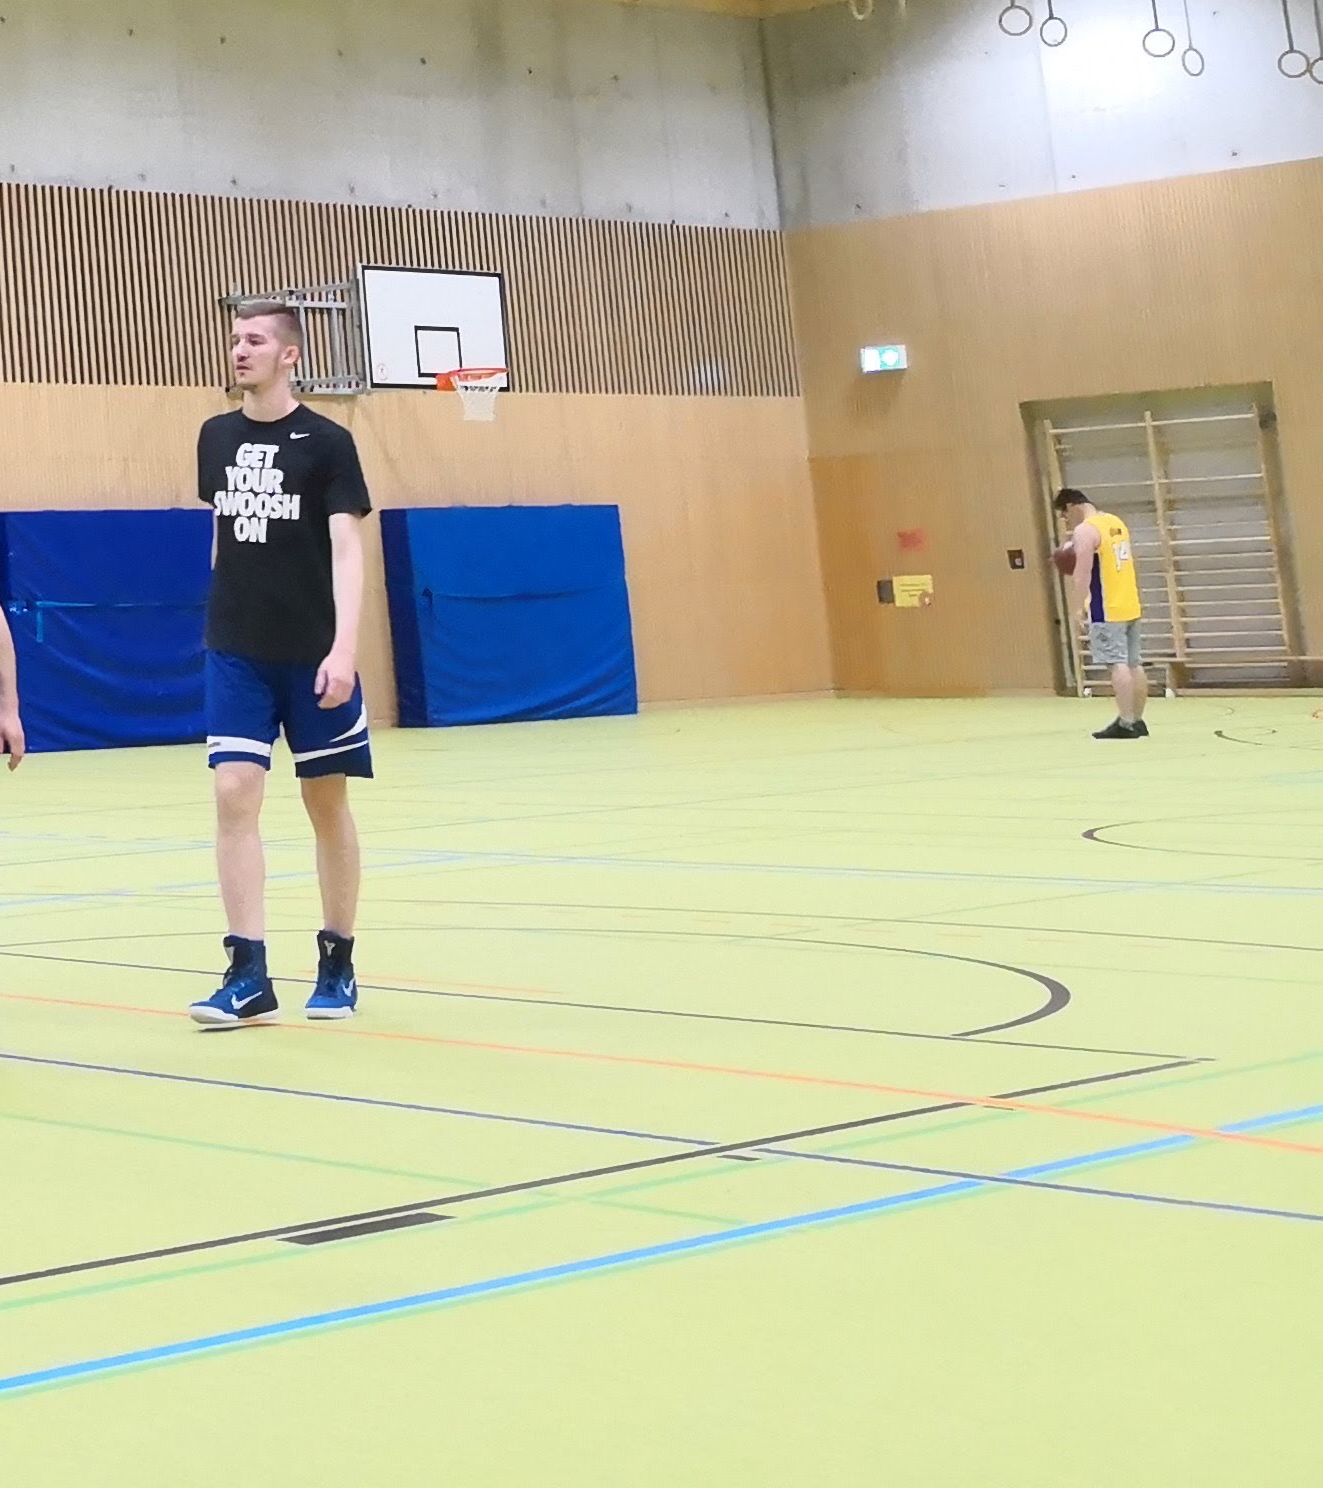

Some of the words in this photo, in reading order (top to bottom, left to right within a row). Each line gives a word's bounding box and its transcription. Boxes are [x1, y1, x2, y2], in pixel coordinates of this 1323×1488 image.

[236, 443, 280, 468] GET
[225, 466, 284, 493] YOUR
[214, 491, 301, 520] SWOOSH
[234, 516, 268, 543] ON
